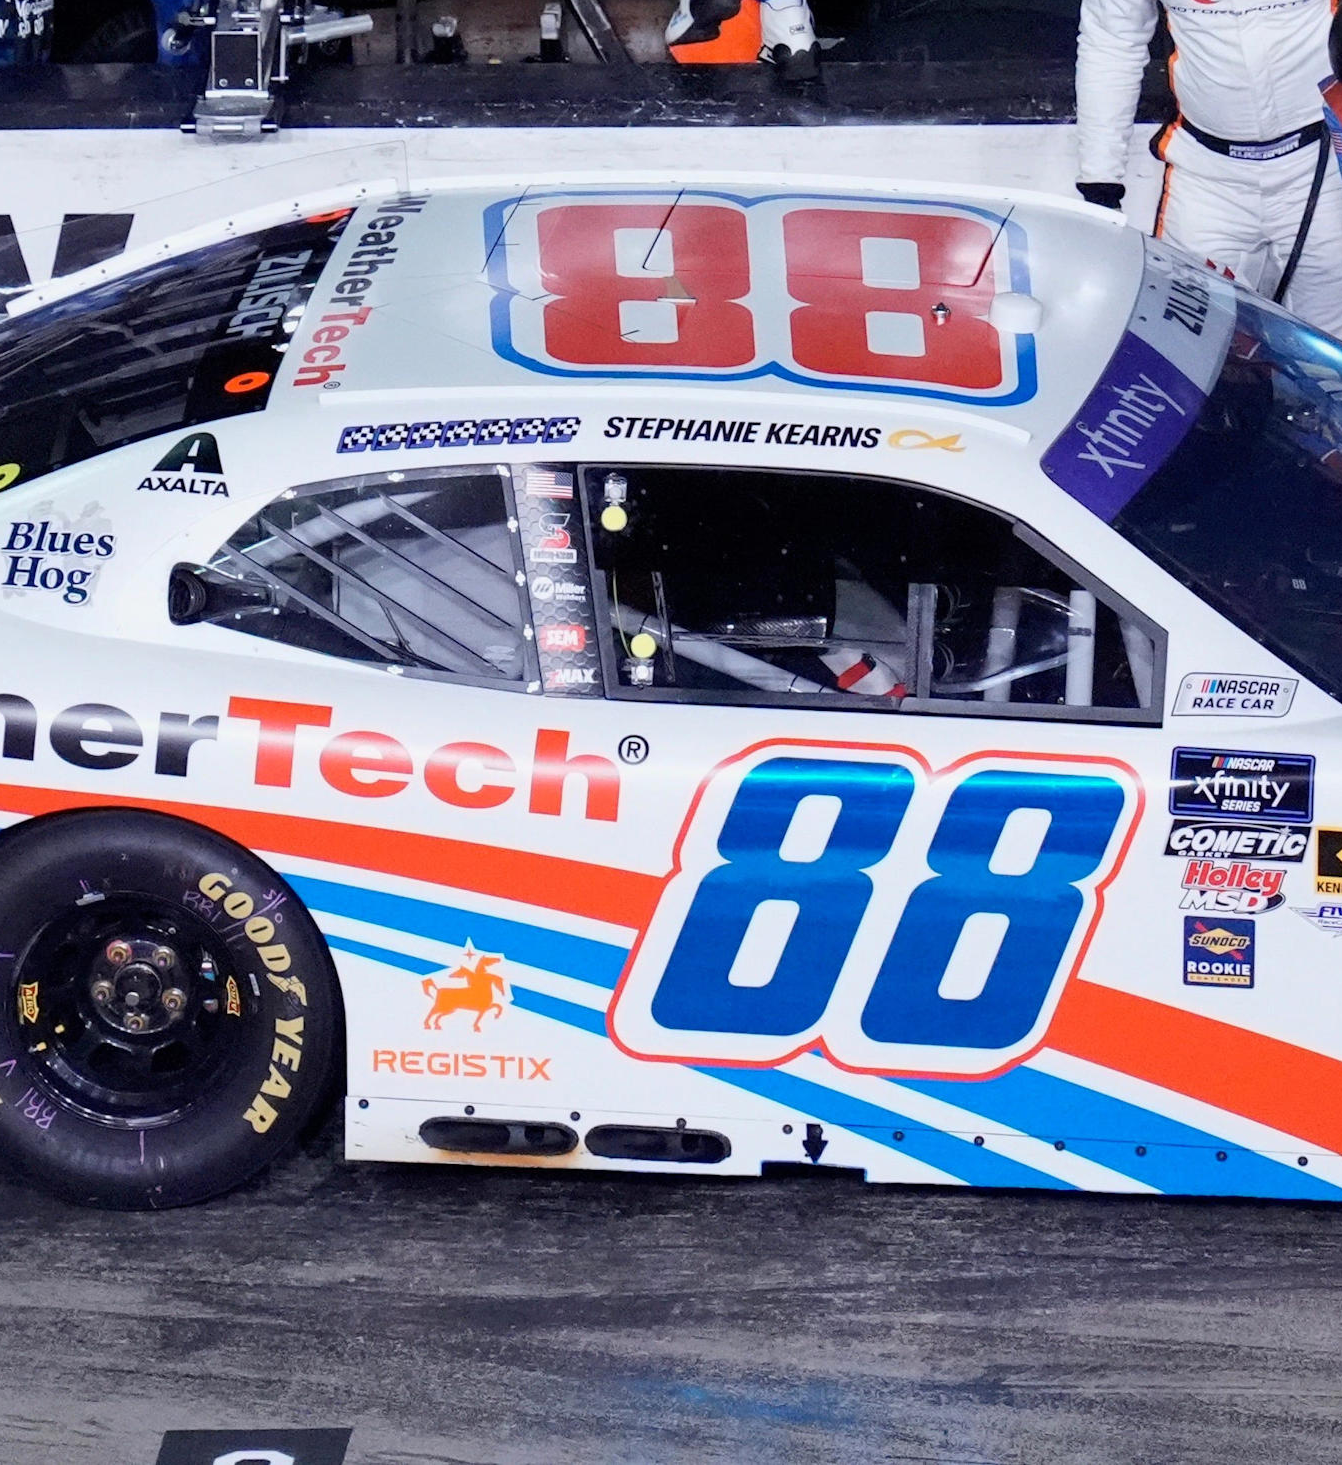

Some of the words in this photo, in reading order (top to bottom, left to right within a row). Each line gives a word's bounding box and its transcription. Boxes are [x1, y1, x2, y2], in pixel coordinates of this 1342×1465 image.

[483, 190, 1039, 407] 88
[1162, 276, 1211, 336] ZILIS
[603, 415, 761, 445] STEPHANIE
[765, 420, 882, 450] KEARNS
[1076, 373, 1186, 479] xfinity
[137, 477, 230, 498] AXALTA
[0, 520, 116, 558] Blues
[0, 556, 93, 605] Hog
[555, 582, 587, 594] Miller
[547, 629, 579, 646] SEM
[1192, 697, 1235, 709] RACE
[1241, 698, 1274, 710] CAR
[1216, 679, 1280, 696] NASCAR
[1227, 756, 1276, 772] NASCAR
[1194, 770, 1291, 808] xfinity
[1220, 799, 1261, 813] SERIES
[1169, 825, 1309, 858] COMETIC
[1183, 860, 1286, 898] Holley
[605, 737, 1145, 1082] 88
[1179, 889, 1285, 915] MSD
[1190, 935, 1250, 948] SUNOCO
[1187, 960, 1252, 976] ROOKIE
[197, 871, 308, 1134] GOODYEAR
[372, 1048, 552, 1082] REGISTIX
